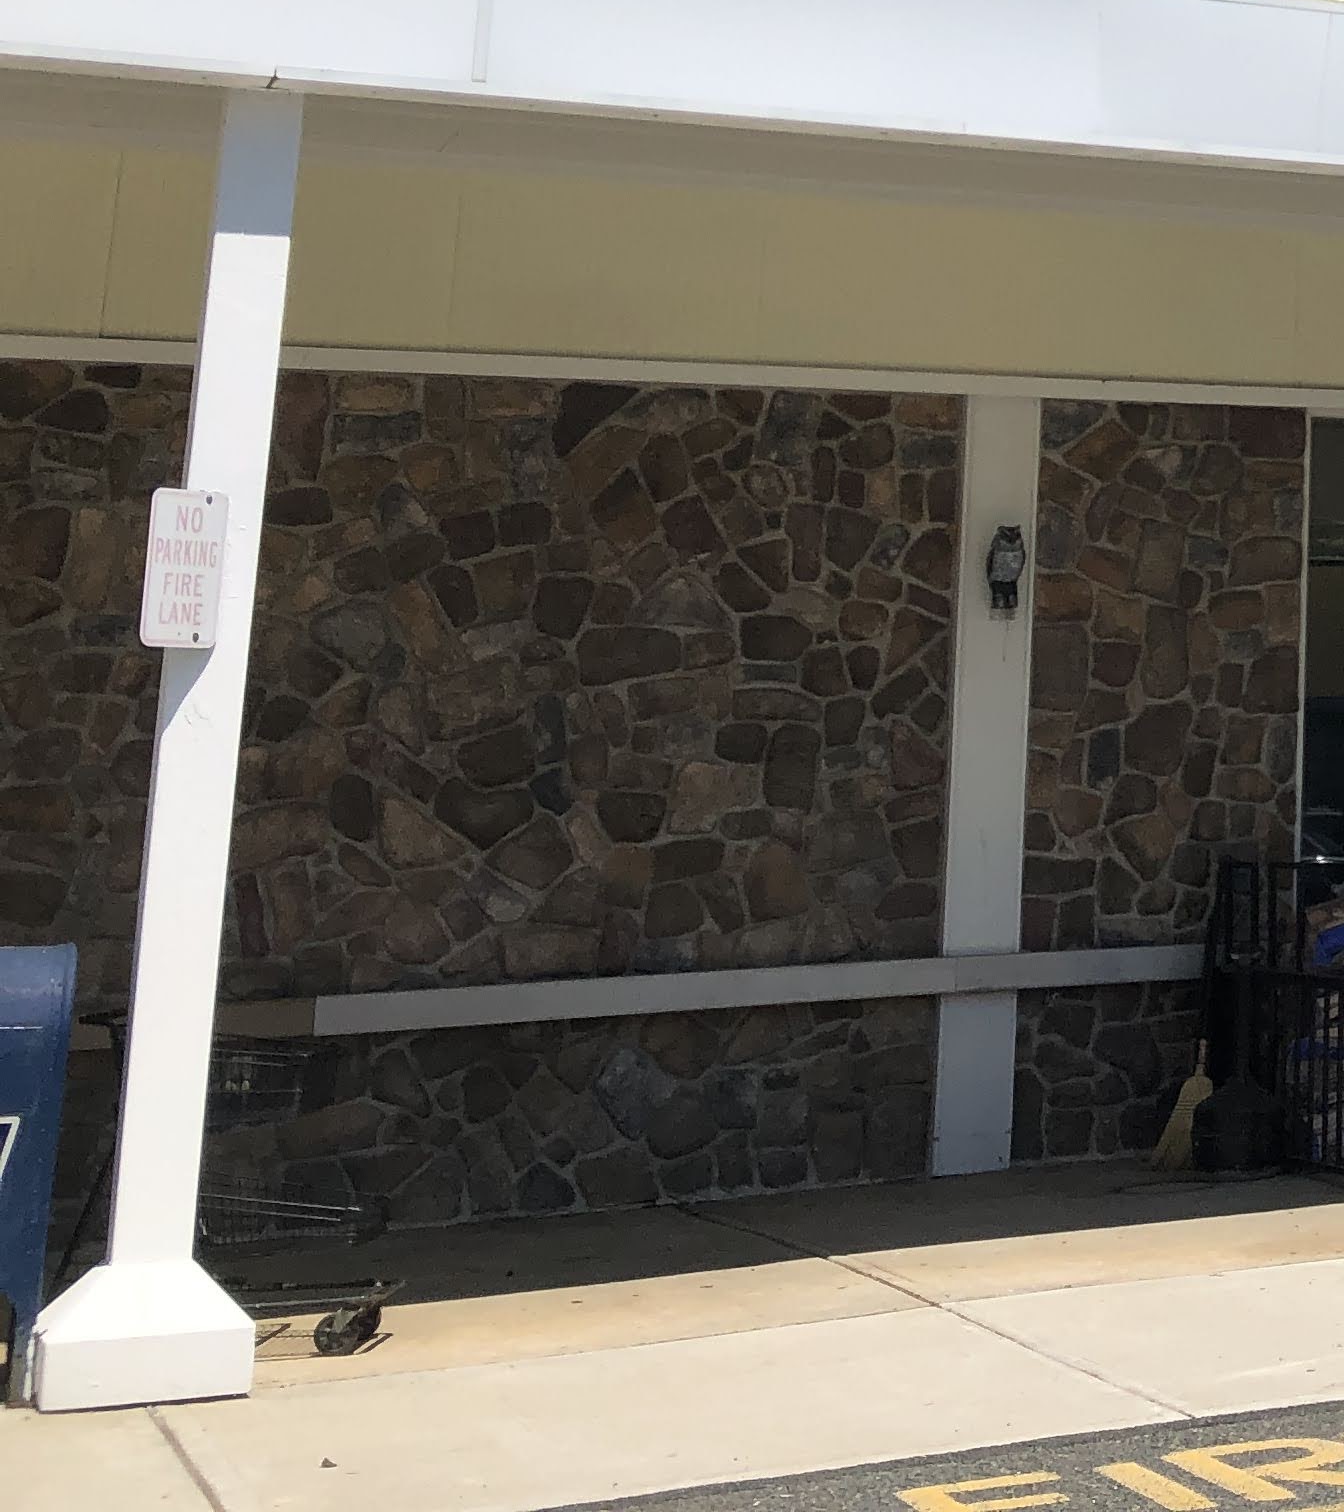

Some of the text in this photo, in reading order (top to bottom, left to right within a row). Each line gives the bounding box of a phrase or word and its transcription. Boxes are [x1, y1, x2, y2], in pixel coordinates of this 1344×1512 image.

[175, 505, 204, 534] NO
[154, 537, 218, 569] PARKING
[162, 572, 204, 598] FIRE
[158, 601, 204, 627] LANE
